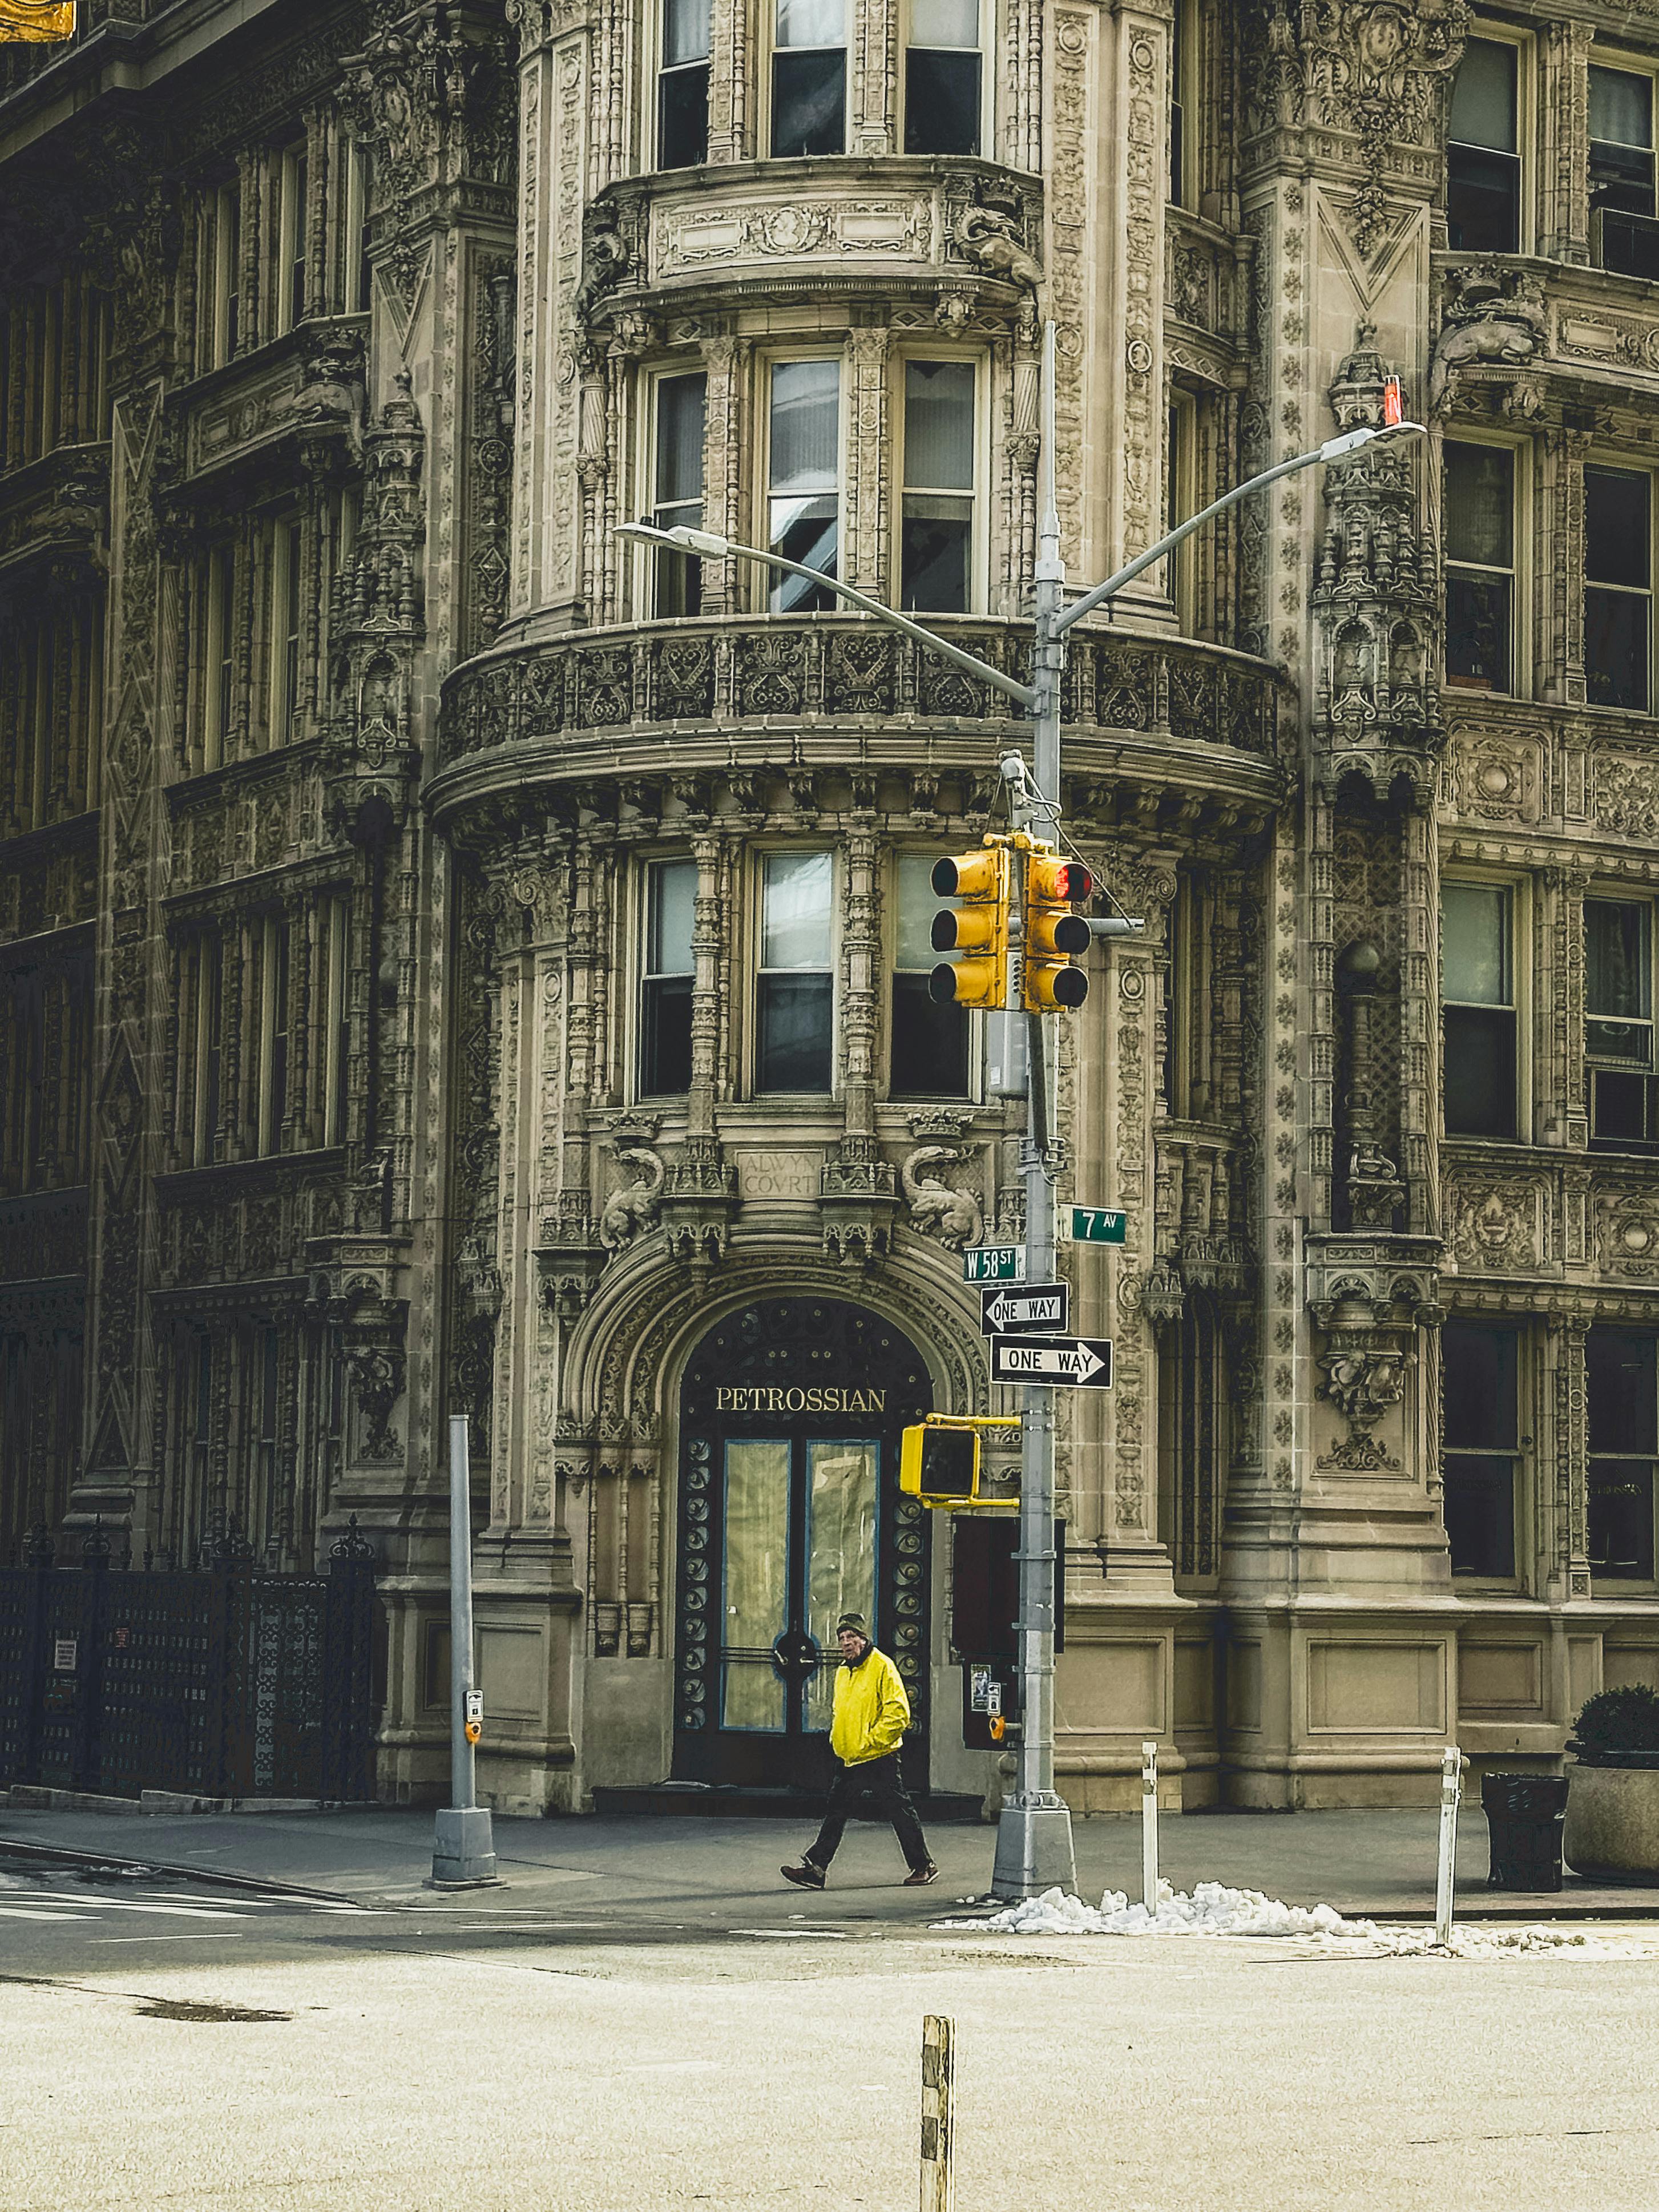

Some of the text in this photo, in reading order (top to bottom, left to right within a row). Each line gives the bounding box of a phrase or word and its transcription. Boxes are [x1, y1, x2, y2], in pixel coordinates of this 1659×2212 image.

[745, 1155, 816, 1172] ALWYN
[1083, 1212, 1117, 1238] 7 AV
[967, 1250, 1012, 1278] W 58 ST
[994, 1299, 1055, 1321] ONE WAY
[1009, 1350, 1093, 1372] ONE WAY
[716, 1387, 887, 1411] PETROSSIAN
